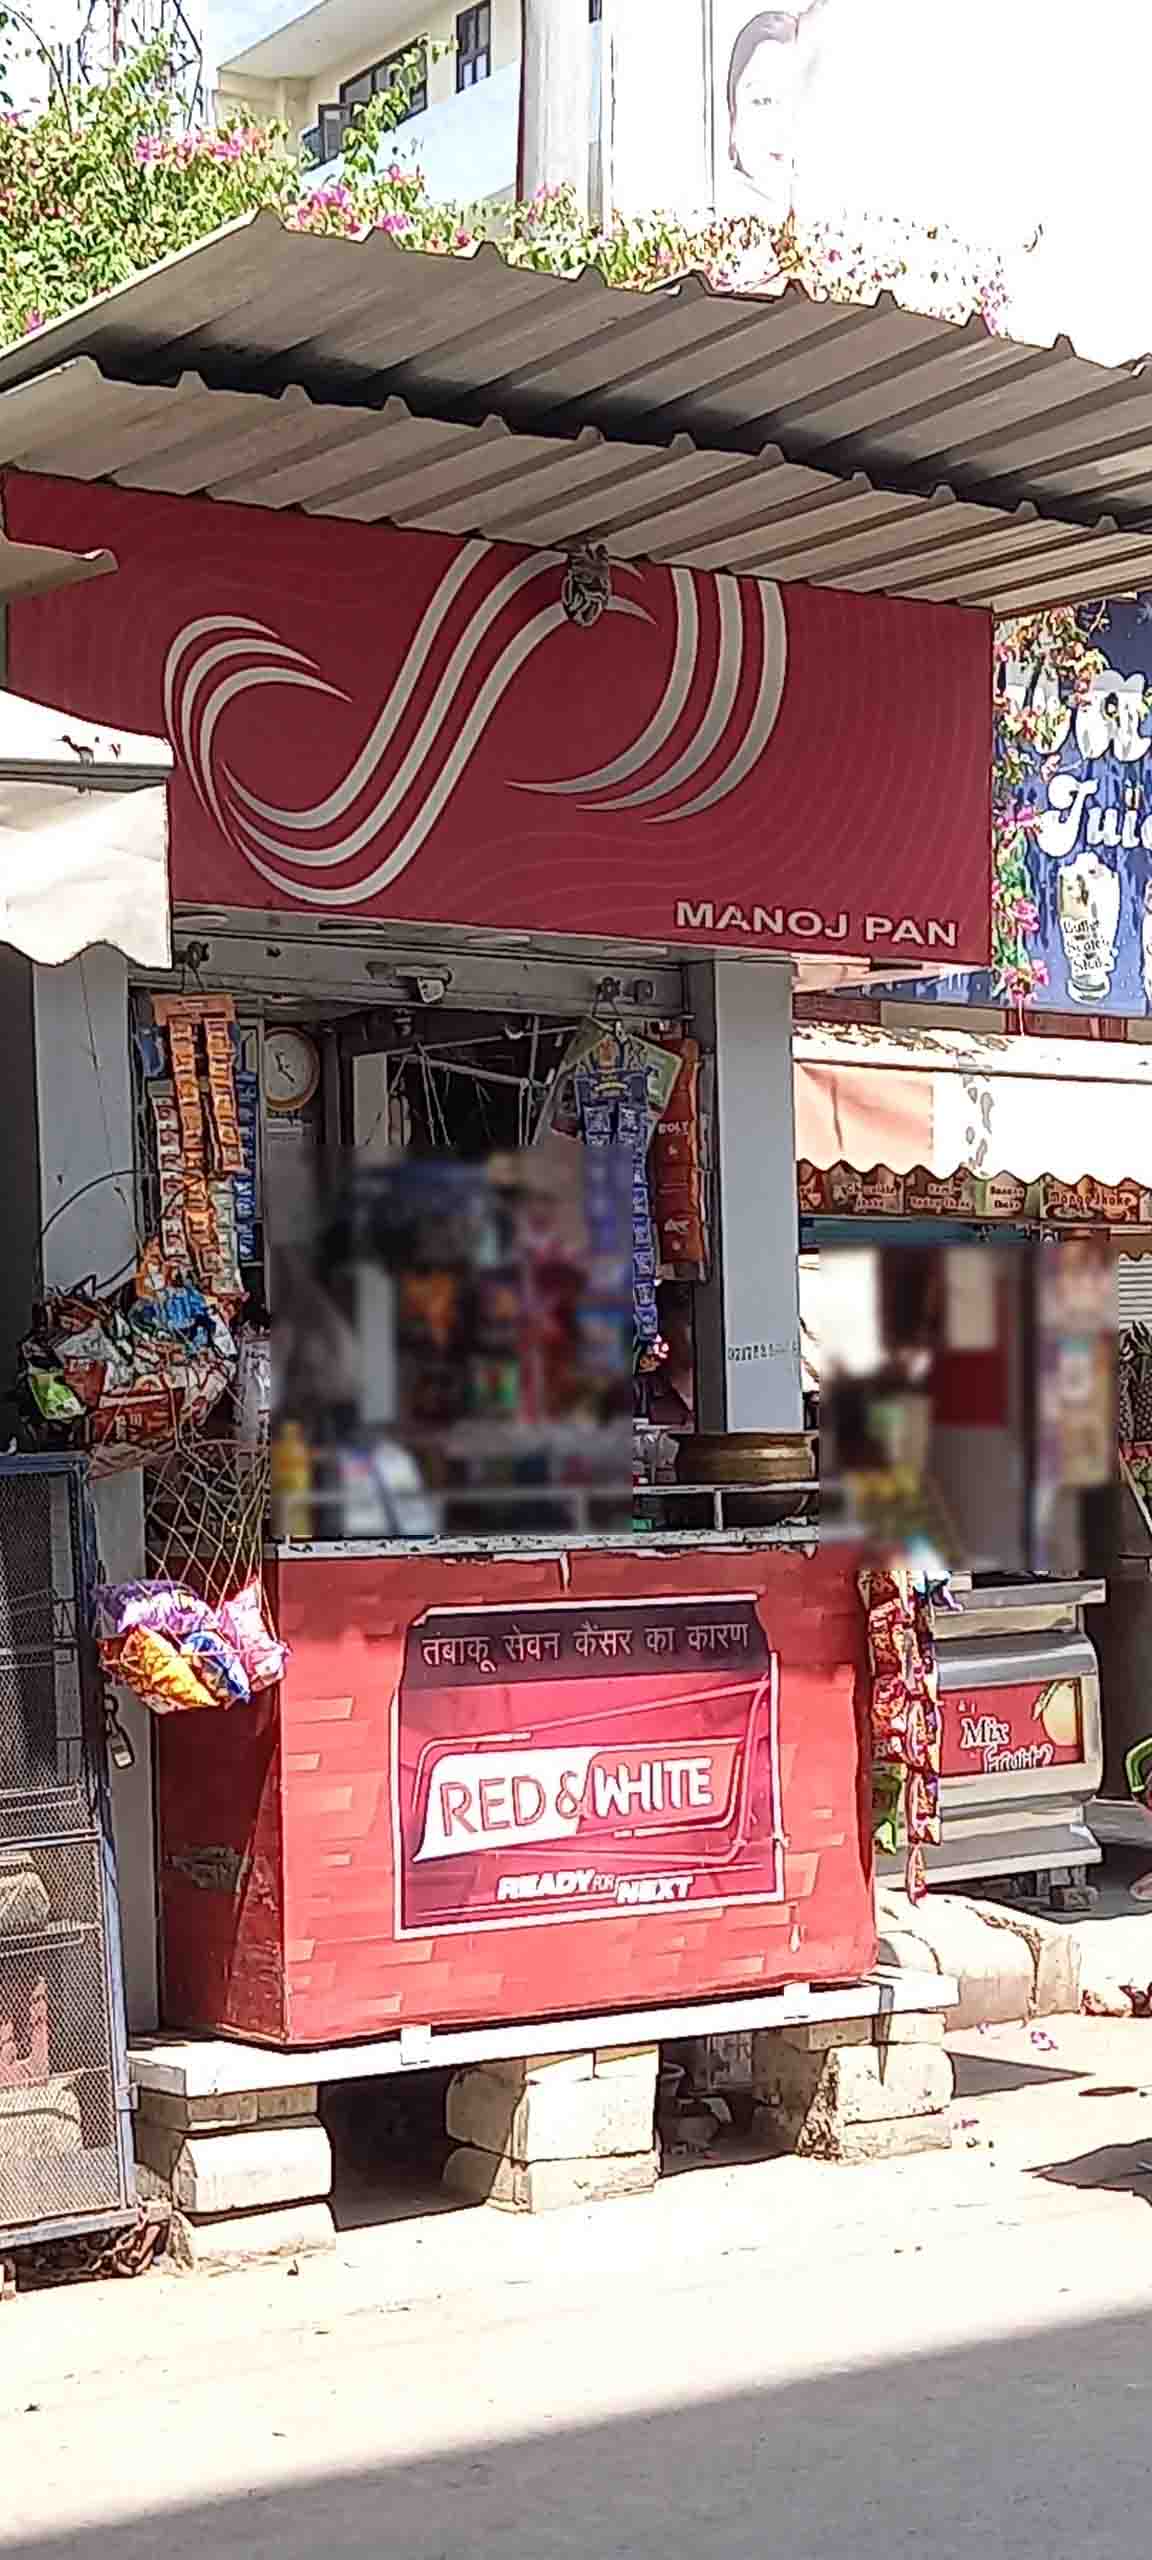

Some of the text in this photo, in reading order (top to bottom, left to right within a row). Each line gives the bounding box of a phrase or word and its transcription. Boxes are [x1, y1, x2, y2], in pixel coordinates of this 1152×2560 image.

[675, 900, 957, 946] MANOJ PAN
[422, 1620, 749, 1672] तंबाकू सेवन कैंसर का कारण
[960, 1716, 1009, 1748] Mix
[439, 1775, 546, 1837] RED
[591, 1757, 714, 1819] WHITE
[497, 1869, 595, 1901] READY
[615, 1876, 694, 1903] NEXT
